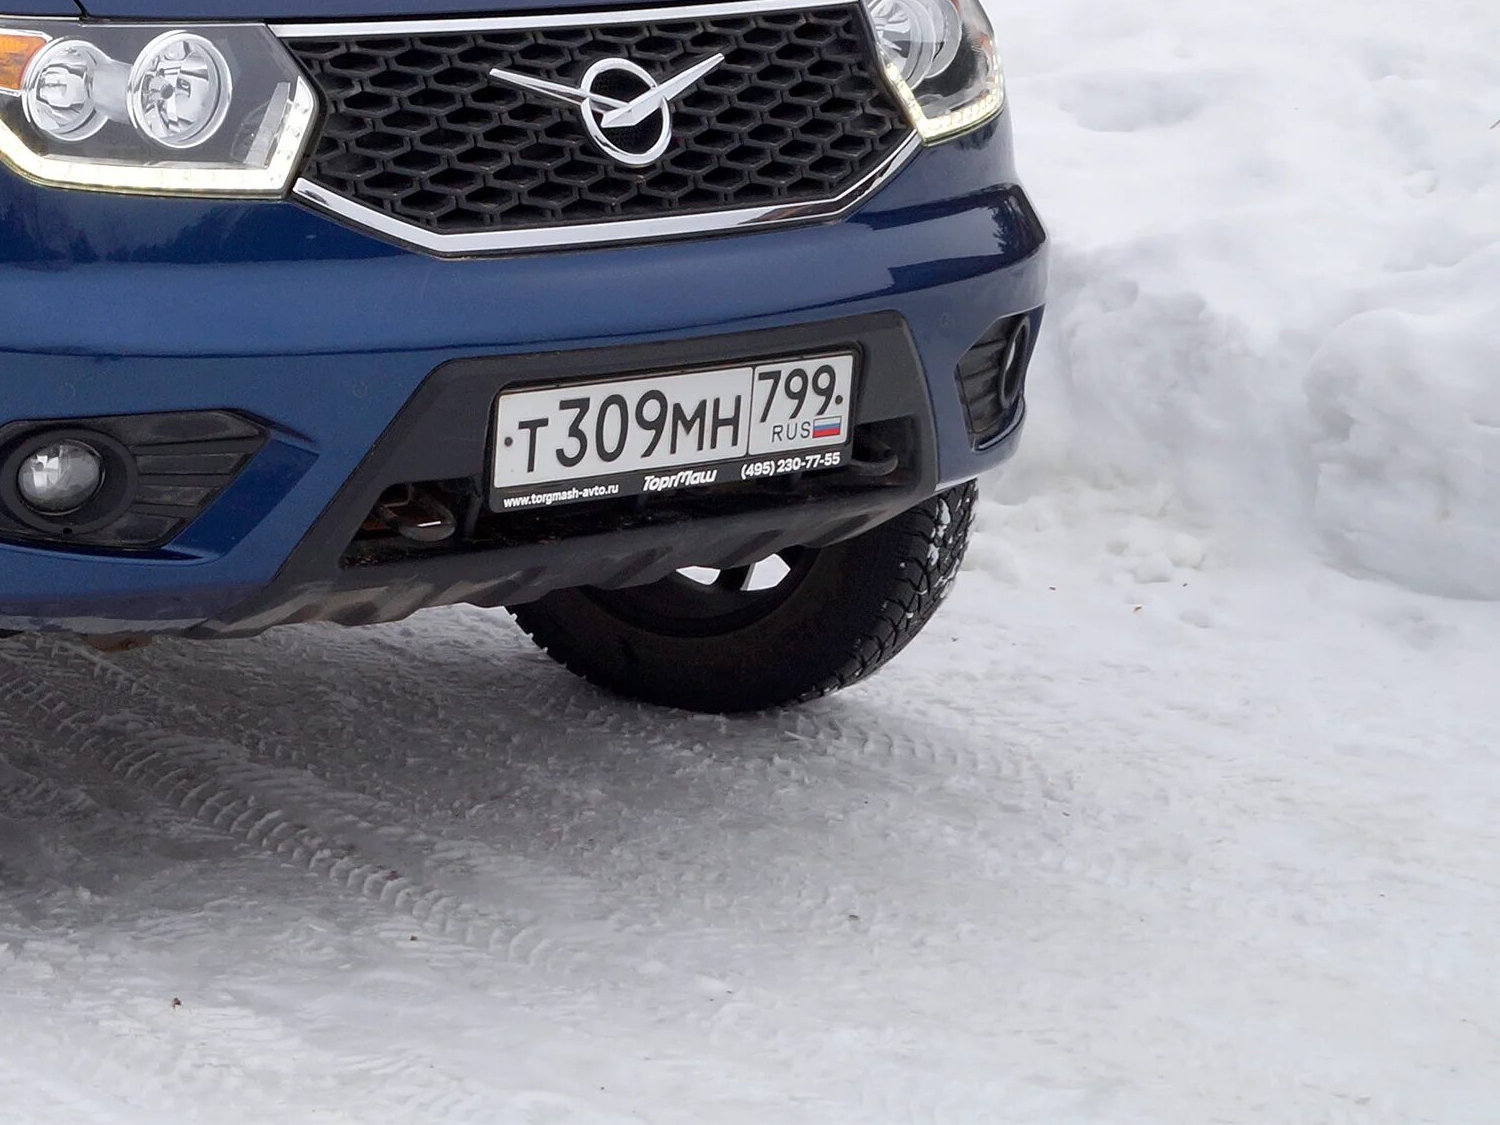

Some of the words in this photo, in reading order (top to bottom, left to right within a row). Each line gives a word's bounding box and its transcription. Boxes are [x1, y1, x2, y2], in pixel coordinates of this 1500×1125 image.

[757, 364, 836, 424] 799
[771, 421, 811, 443] RUS
[741, 461, 775, 480] (495)
[776, 451, 841, 473] 230-77-55
[503, 483, 619, 508] www.torgmash-avto.ru
